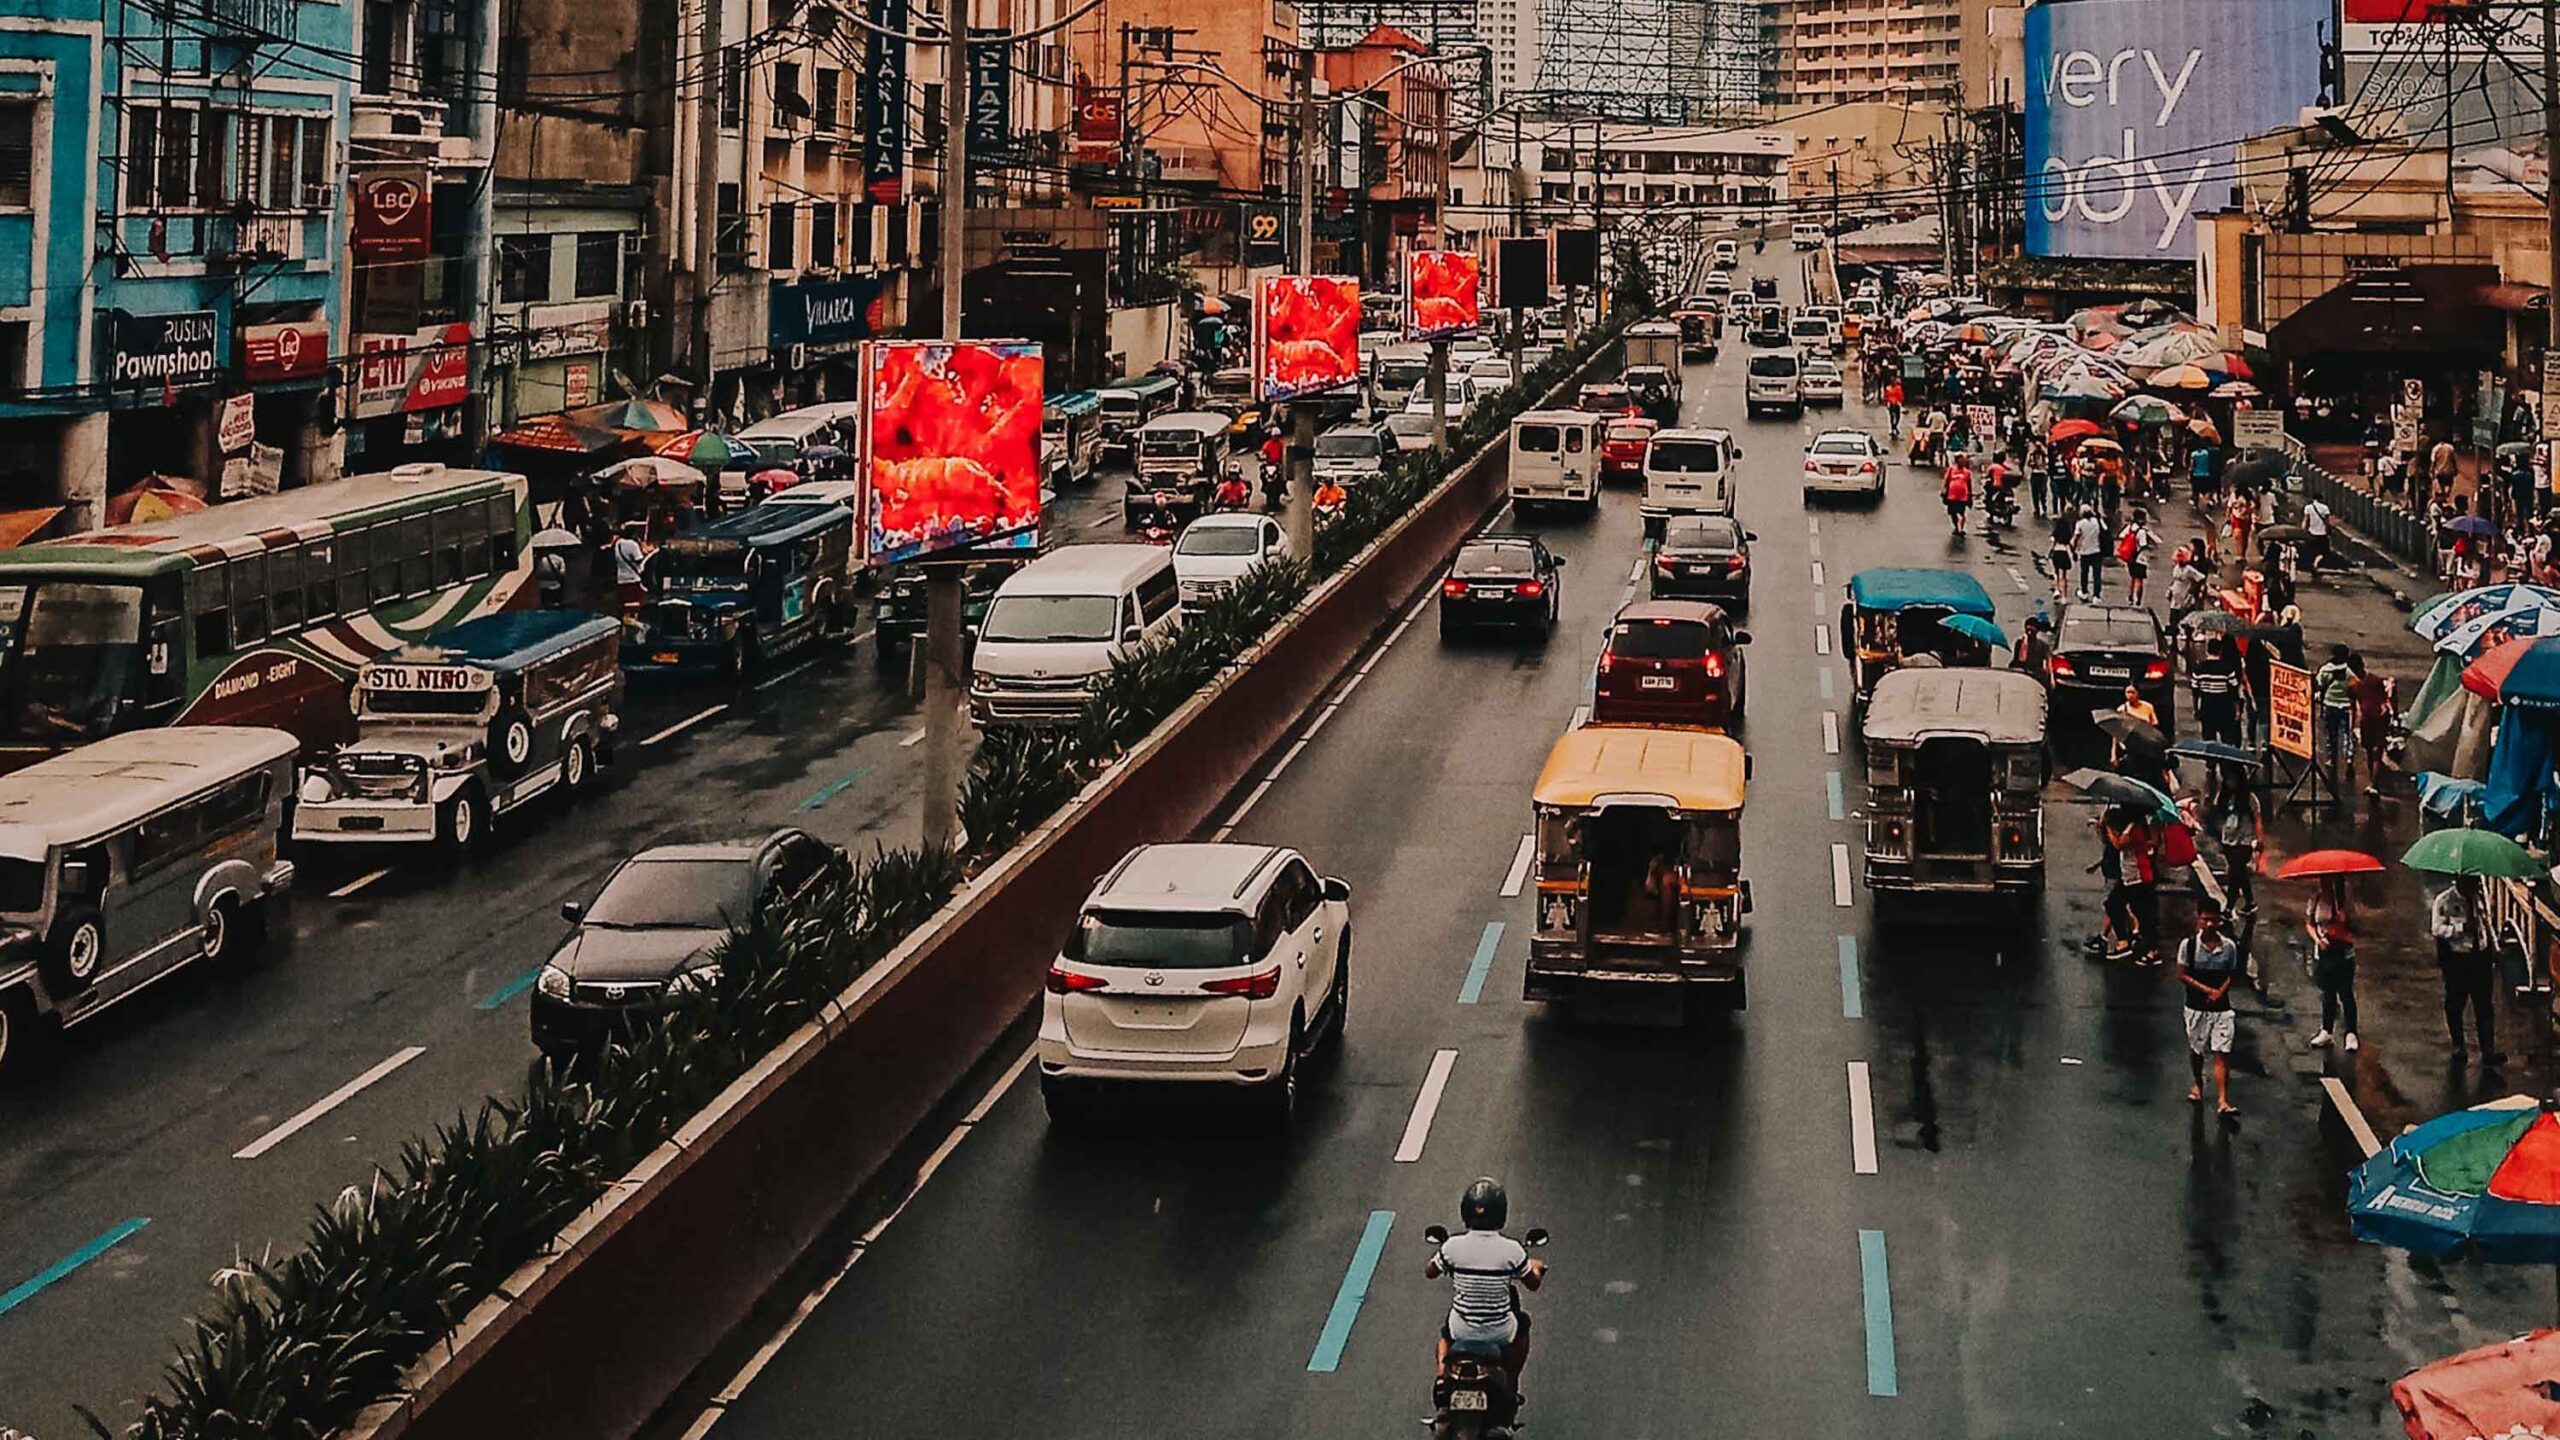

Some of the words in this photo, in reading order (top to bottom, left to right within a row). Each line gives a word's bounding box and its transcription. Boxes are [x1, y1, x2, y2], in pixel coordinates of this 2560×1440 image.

[373, 193, 411, 209] LBC
[1251, 214, 1279, 239] 99
[164, 319, 213, 344] RUSLIN
[115, 346, 213, 380] Pawnshop
[215, 672, 259, 700] DIAMOND
[371, 668, 411, 689] STO.
